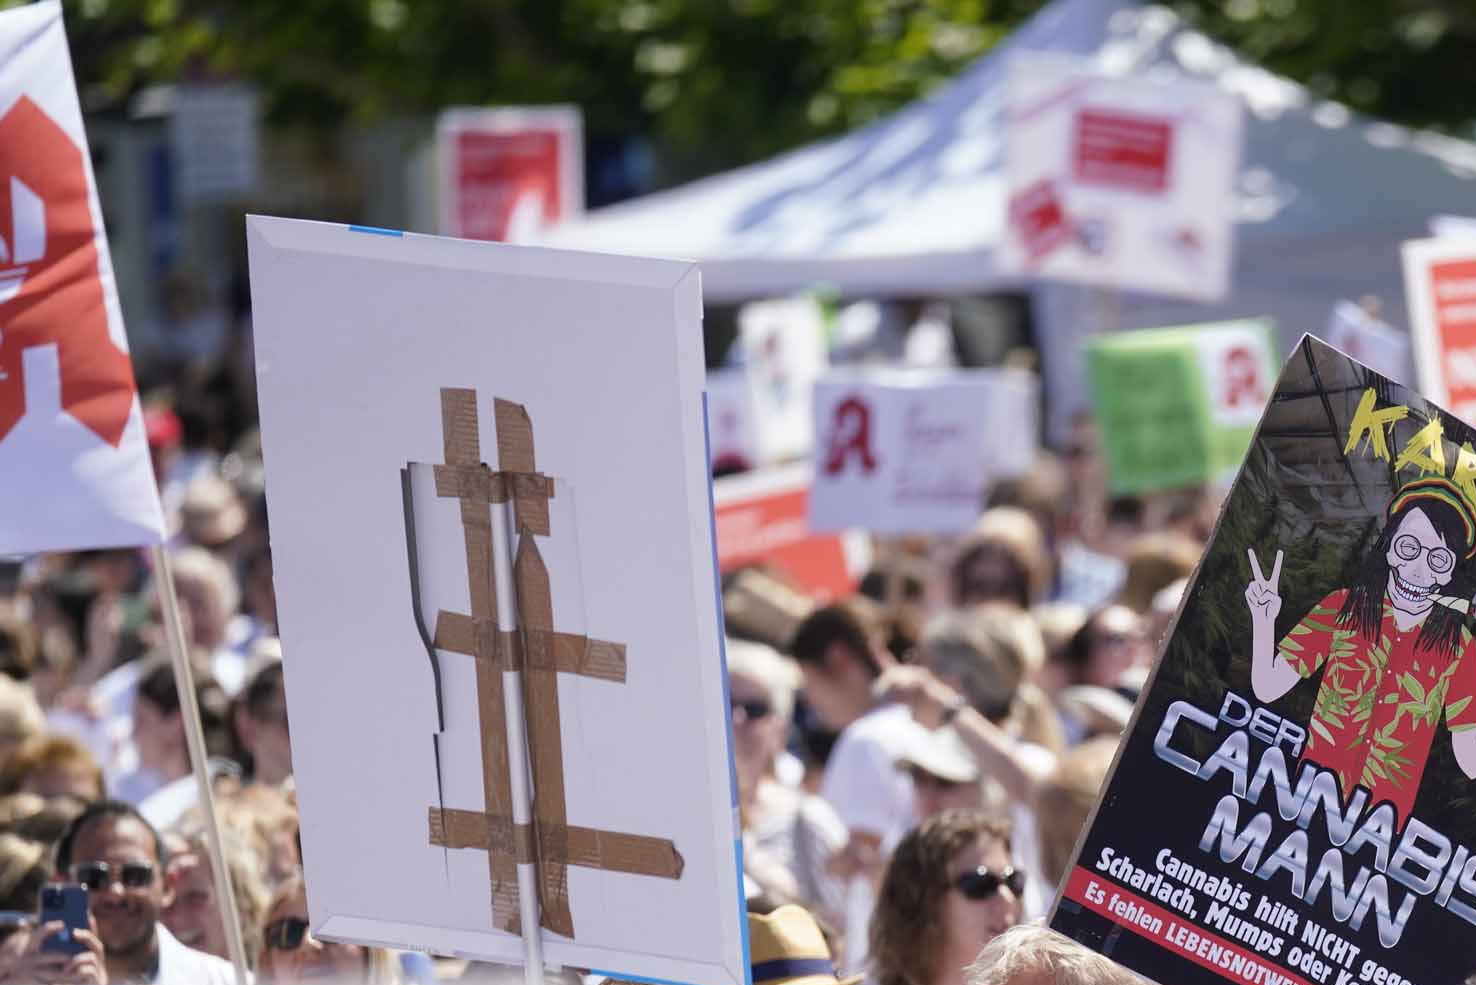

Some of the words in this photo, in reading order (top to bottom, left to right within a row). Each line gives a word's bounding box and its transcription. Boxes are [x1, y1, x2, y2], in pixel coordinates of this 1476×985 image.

[1219, 691, 1306, 757] DER
[1084, 881, 1107, 905] Es
[1108, 893, 1163, 935] fehlen
[1096, 847, 1198, 920] Scharlach,
[1204, 901, 1284, 956] Mumps
[1287, 946, 1332, 983] oder
[1155, 848, 1252, 911] Cannabis
[1254, 896, 1299, 935] hilft
[1301, 920, 1361, 968] NICHT
[1199, 795, 1417, 948] MANN
